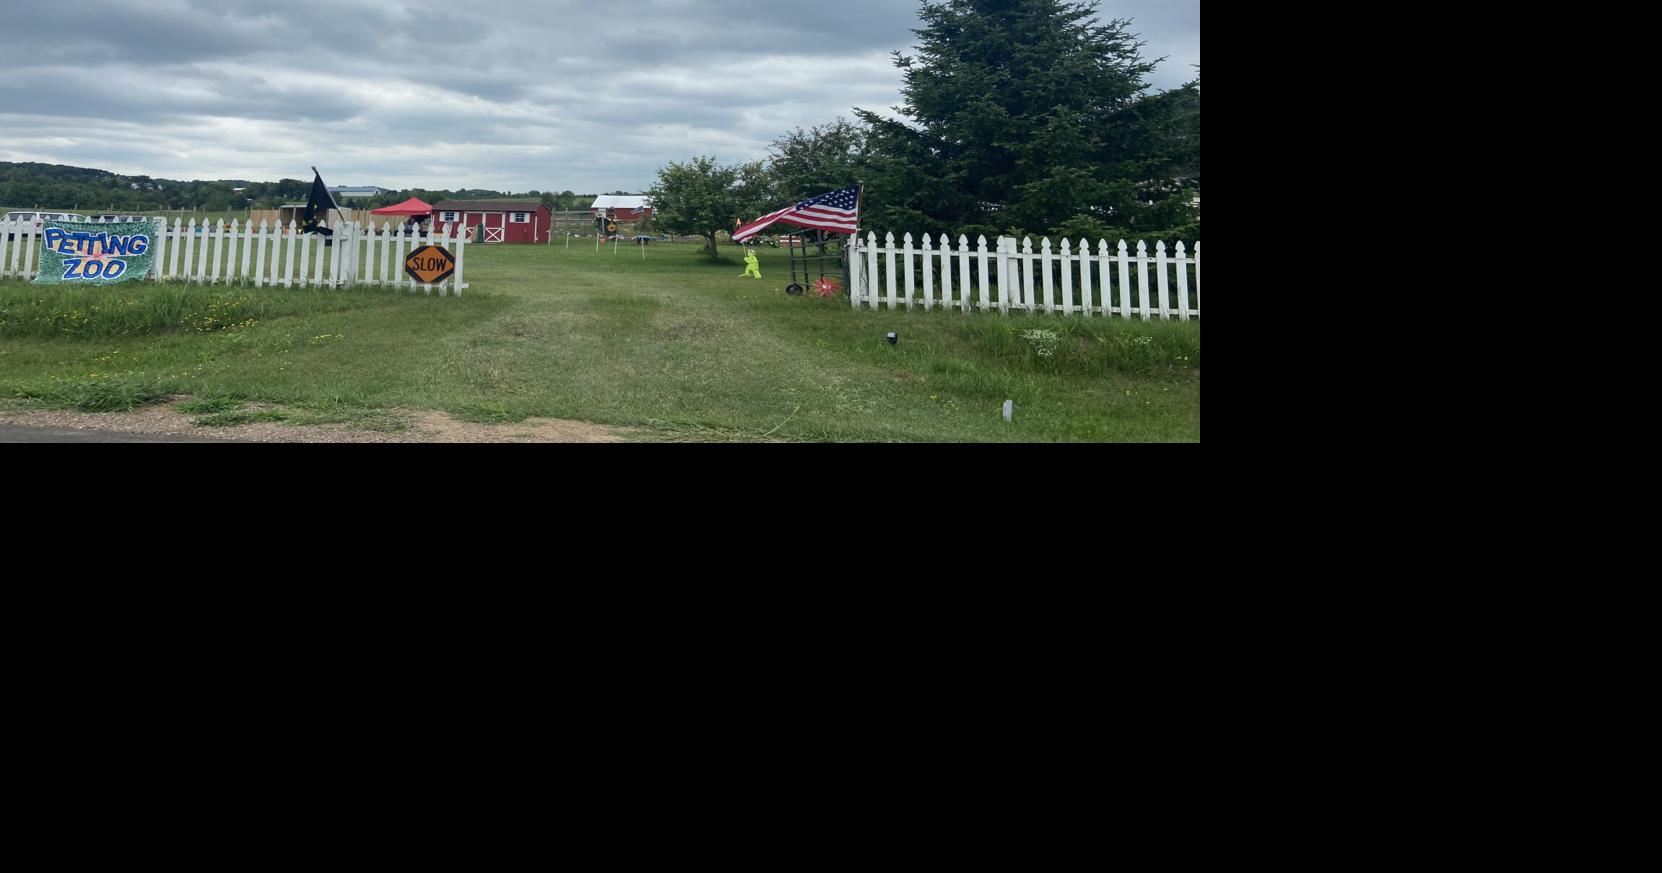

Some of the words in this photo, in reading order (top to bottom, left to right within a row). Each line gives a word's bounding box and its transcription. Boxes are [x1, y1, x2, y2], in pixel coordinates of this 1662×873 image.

[44, 228, 149, 256] PETTING
[62, 258, 127, 280] ZOO
[412, 257, 447, 272] SLOW
